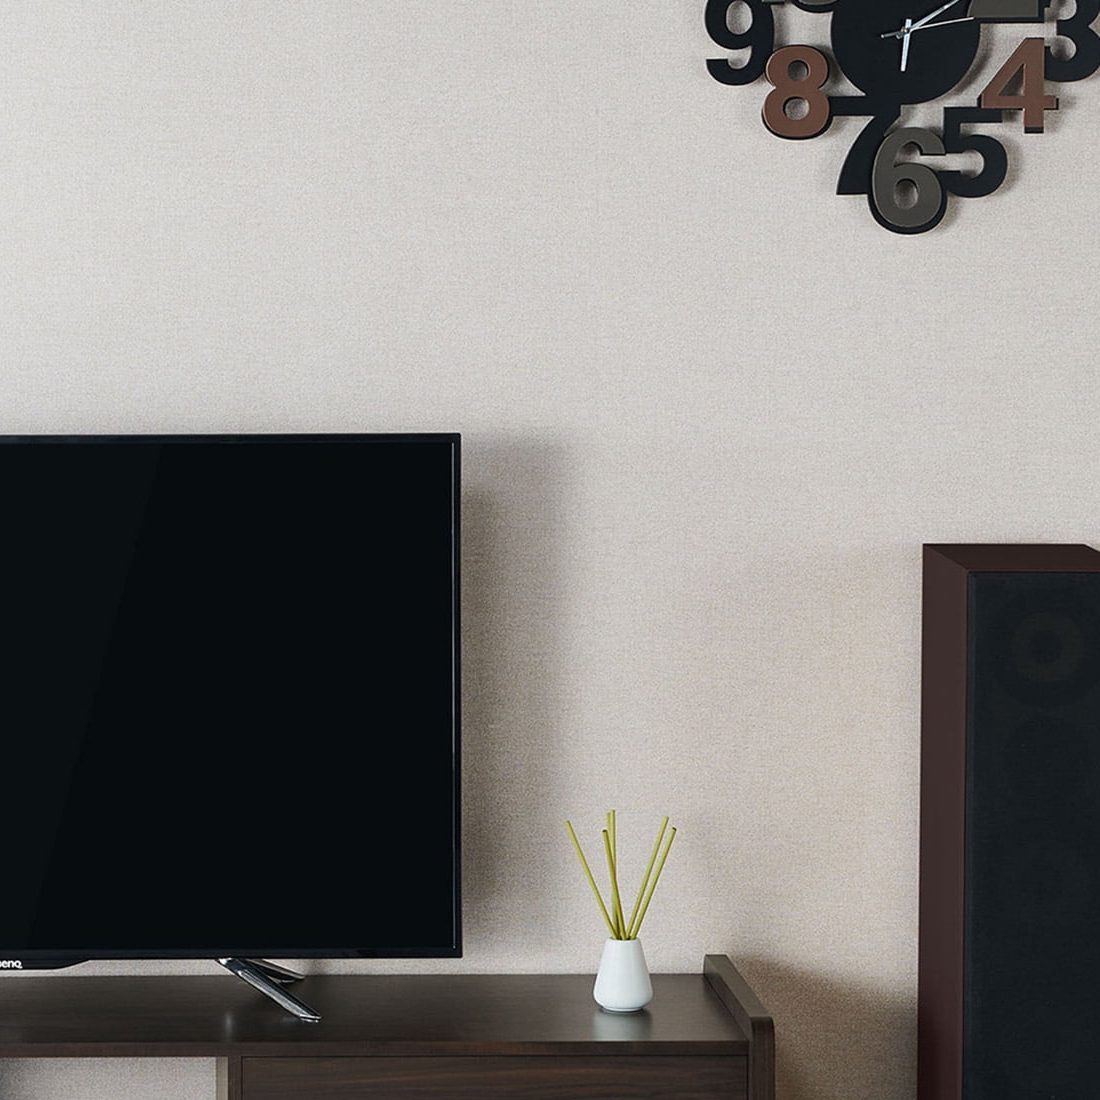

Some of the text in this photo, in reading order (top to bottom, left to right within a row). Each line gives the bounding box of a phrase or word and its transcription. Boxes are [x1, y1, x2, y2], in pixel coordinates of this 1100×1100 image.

[705, 0, 775, 86] 9
[977, 37, 1059, 134] 4
[1044, 0, 1100, 82] 3
[762, 45, 834, 141] 8
[830, 95, 901, 195] 7
[868, 127, 947, 235] 6
[939, 107, 1008, 198] 5
